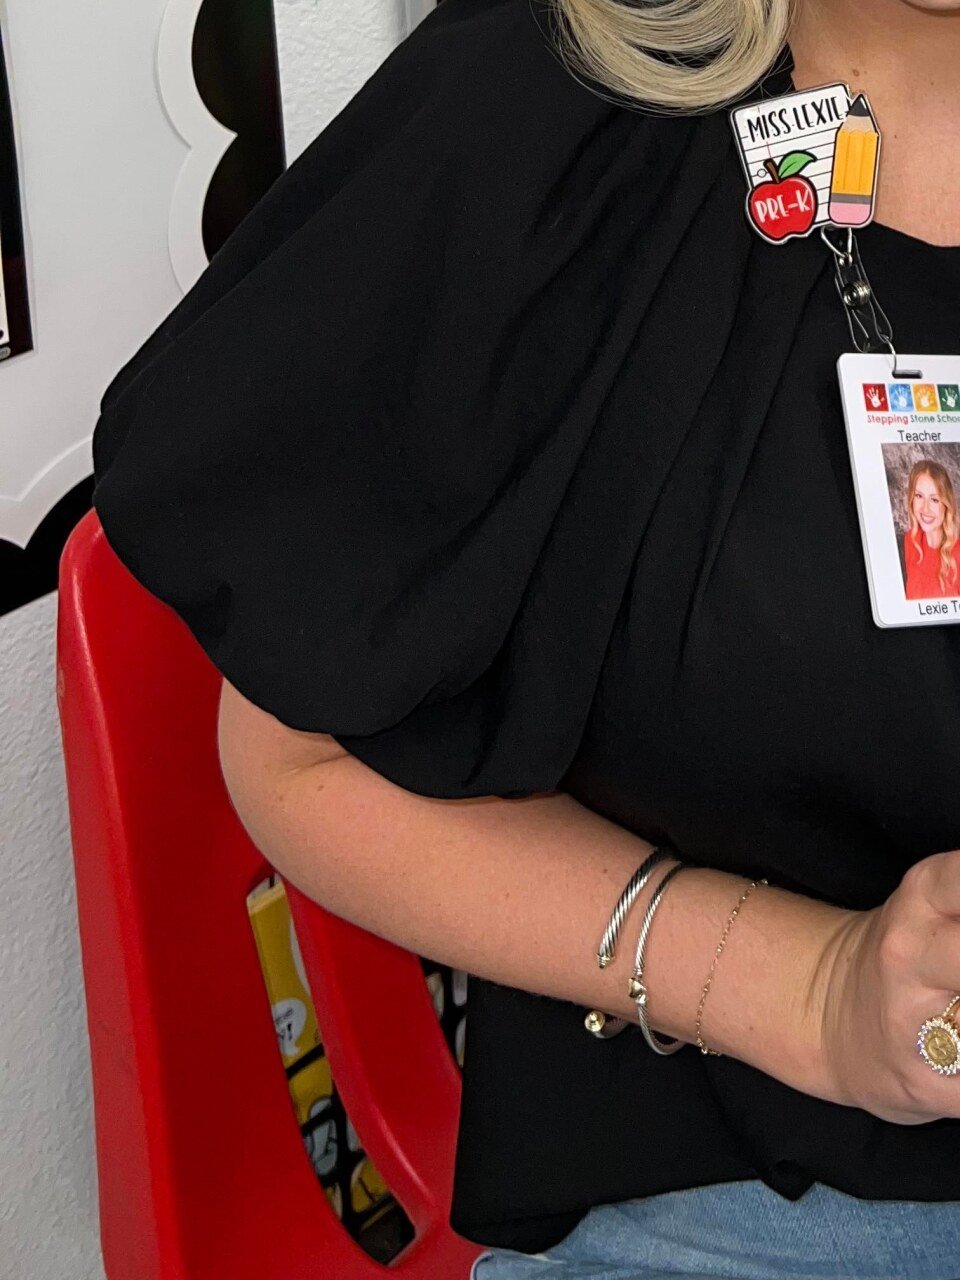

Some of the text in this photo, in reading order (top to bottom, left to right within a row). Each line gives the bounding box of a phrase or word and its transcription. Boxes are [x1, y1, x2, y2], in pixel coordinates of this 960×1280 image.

[746, 96, 845, 143] MISS LEXIE
[754, 189, 811, 223] PRE-K
[867, 414, 908, 425] Stepping
[910, 414, 935, 423] Stone
[897, 429, 941, 442] Teacher
[918, 601, 948, 615] Lexie
